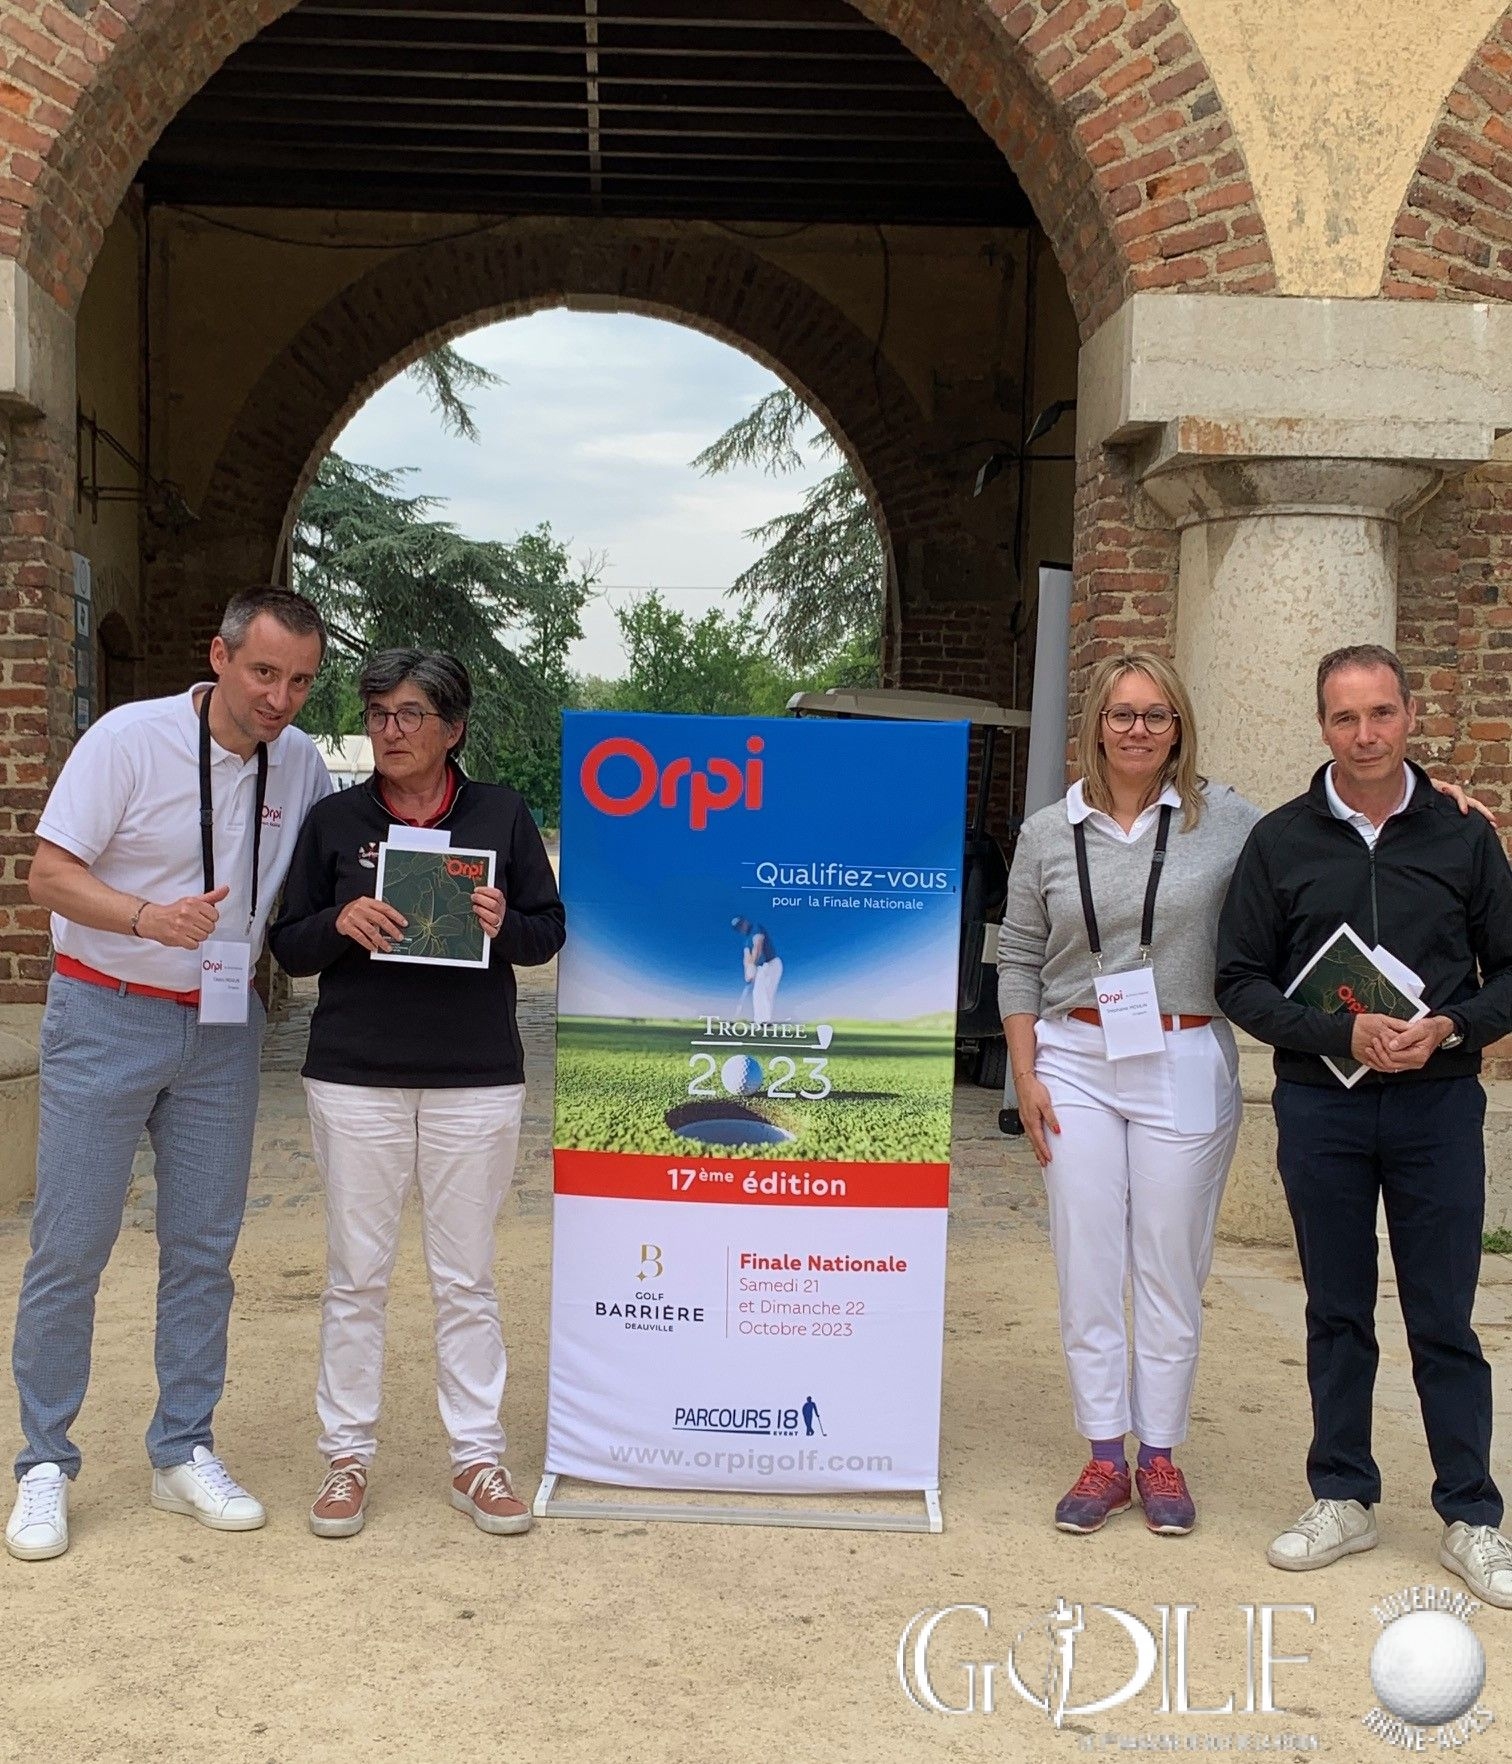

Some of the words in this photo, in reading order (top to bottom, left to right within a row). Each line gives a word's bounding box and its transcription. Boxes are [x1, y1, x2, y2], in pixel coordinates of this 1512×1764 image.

[580, 736, 765, 831] Orpi
[262, 805, 282, 821] Orpi
[446, 859, 484, 880] Orpi
[756, 862, 948, 889] Qualifiez-vous
[772, 896, 802, 908] pour
[808, 896, 820, 907] la
[823, 897, 861, 909] Finale
[863, 898, 924, 911] Nationale
[203, 960, 223, 973] Orpi
[1099, 990, 1124, 1004] Orpi
[688, 1053, 833, 1100] 2023
[742, 1171, 847, 1197] édition
[740, 1253, 802, 1271] Finale
[808, 1255, 908, 1273] Nationale
[739, 1277, 799, 1293] Samedi
[803, 1279, 820, 1293] 21
[635, 1292, 664, 1301] GOLF
[738, 1301, 755, 1313] et
[760, 1299, 841, 1316] Dimanche
[845, 1301, 865, 1315] 22
[624, 1322, 674, 1332] DEAUVILLE
[738, 1320, 807, 1336] Octobre
[811, 1322, 854, 1337] 2023
[674, 1407, 772, 1429] PARCOURS
[776, 1409, 799, 1429] 18
[609, 1445, 893, 1475] www.orpigolf.com
